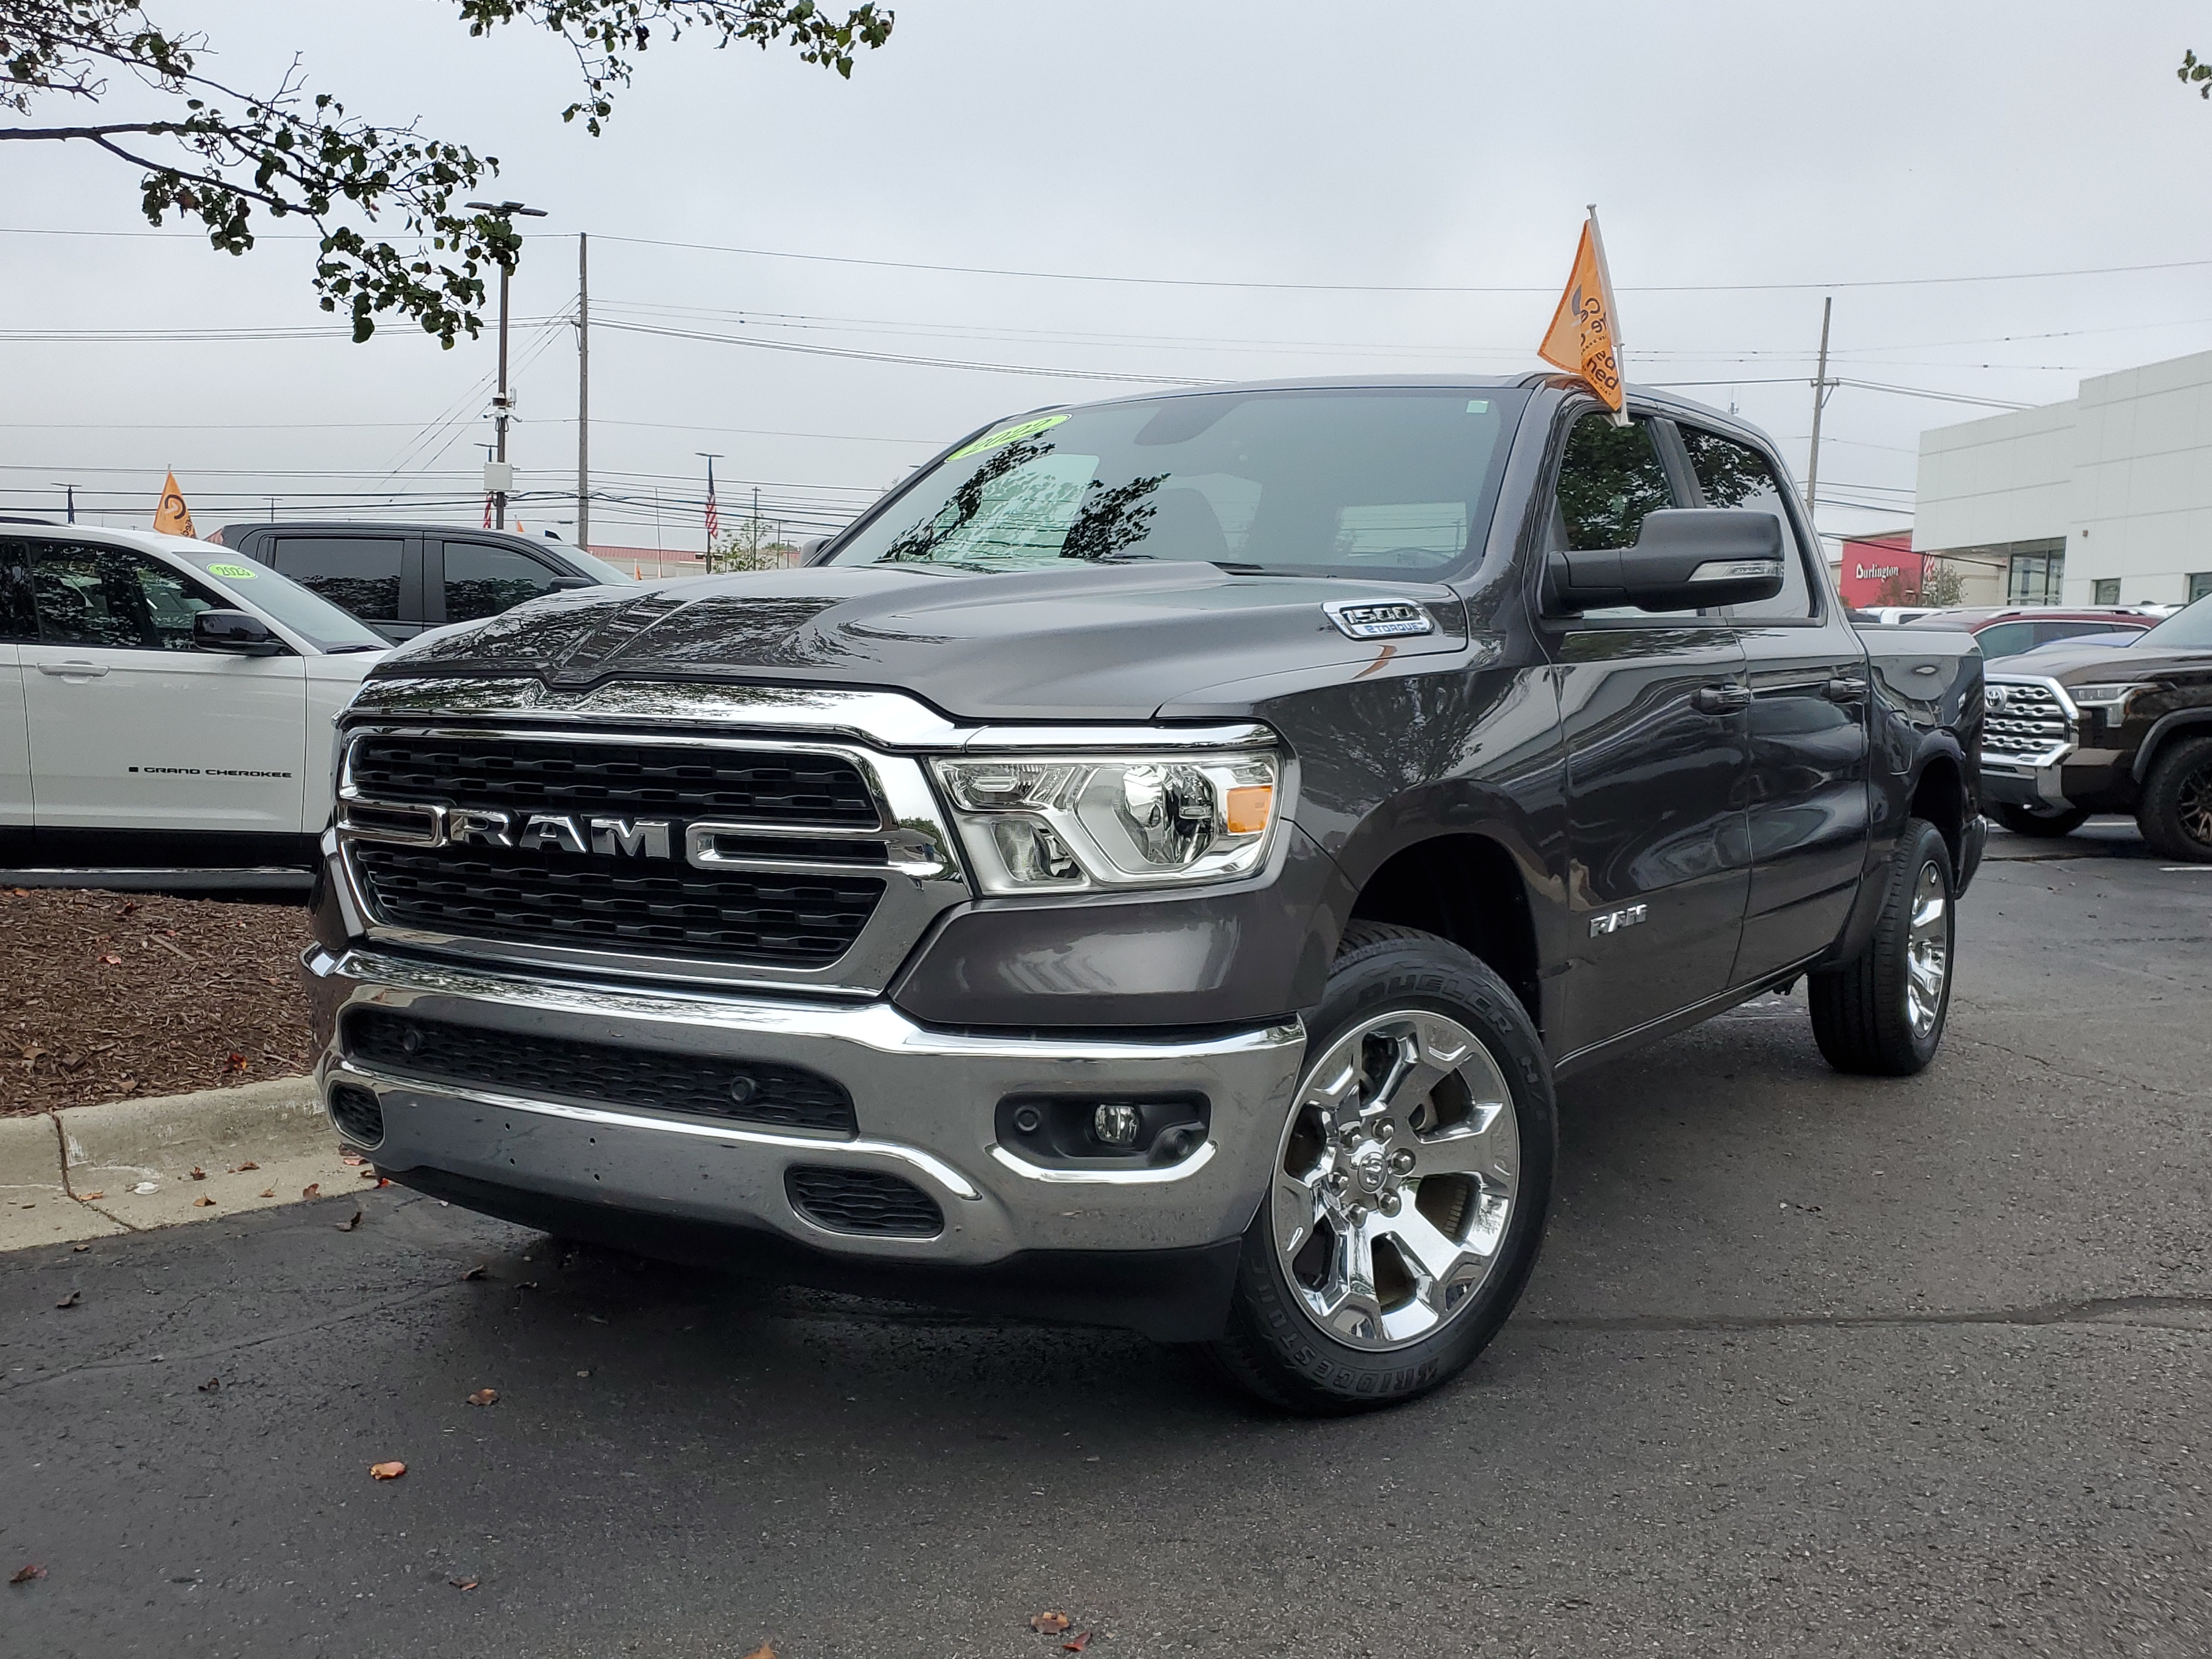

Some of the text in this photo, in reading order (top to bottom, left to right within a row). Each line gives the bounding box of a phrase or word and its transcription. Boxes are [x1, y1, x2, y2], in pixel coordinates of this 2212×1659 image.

[961, 419, 1052, 457] 2022
[1856, 563, 1899, 582] Burlington
[1342, 606, 1414, 624] 1500
[205, 769, 292, 778] CHEROKEE
[449, 808, 671, 859] RAM
[1590, 904, 1647, 938] RAM
[1357, 973, 1513, 1035] DUELER
[1250, 1256, 1440, 1394] BRIDGESTONE
